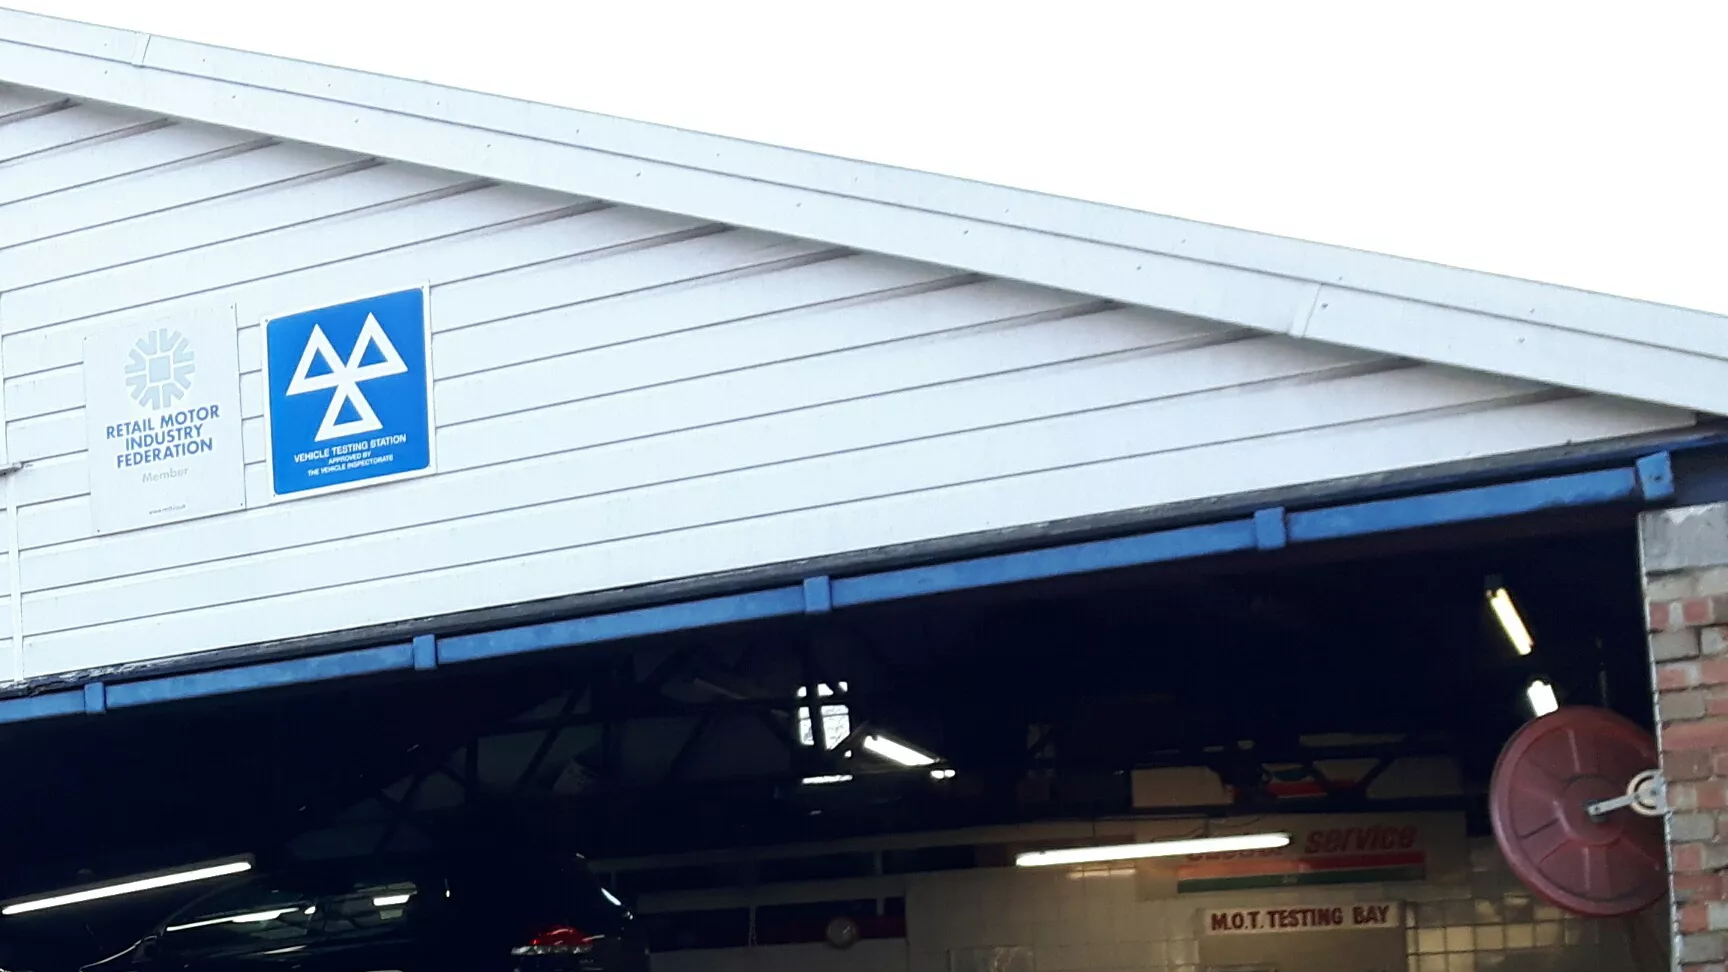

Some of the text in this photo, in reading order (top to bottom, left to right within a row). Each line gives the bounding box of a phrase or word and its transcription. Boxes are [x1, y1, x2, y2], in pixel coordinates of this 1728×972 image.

[106, 404, 220, 439] RETAIL MOTOR
[125, 423, 203, 451] INDUSTRY
[294, 433, 407, 463] VEHICLE TESTING STATION
[117, 437, 212, 468] FEDERATION
[307, 454, 394, 477] THE VEHICLE INSPECTORATE
[328, 450, 372, 465] APPROVED BY
[142, 467, 189, 483] Member
[1304, 825, 1419, 854] service
[1211, 905, 1390, 930] M.O.T. TESTING BAY
